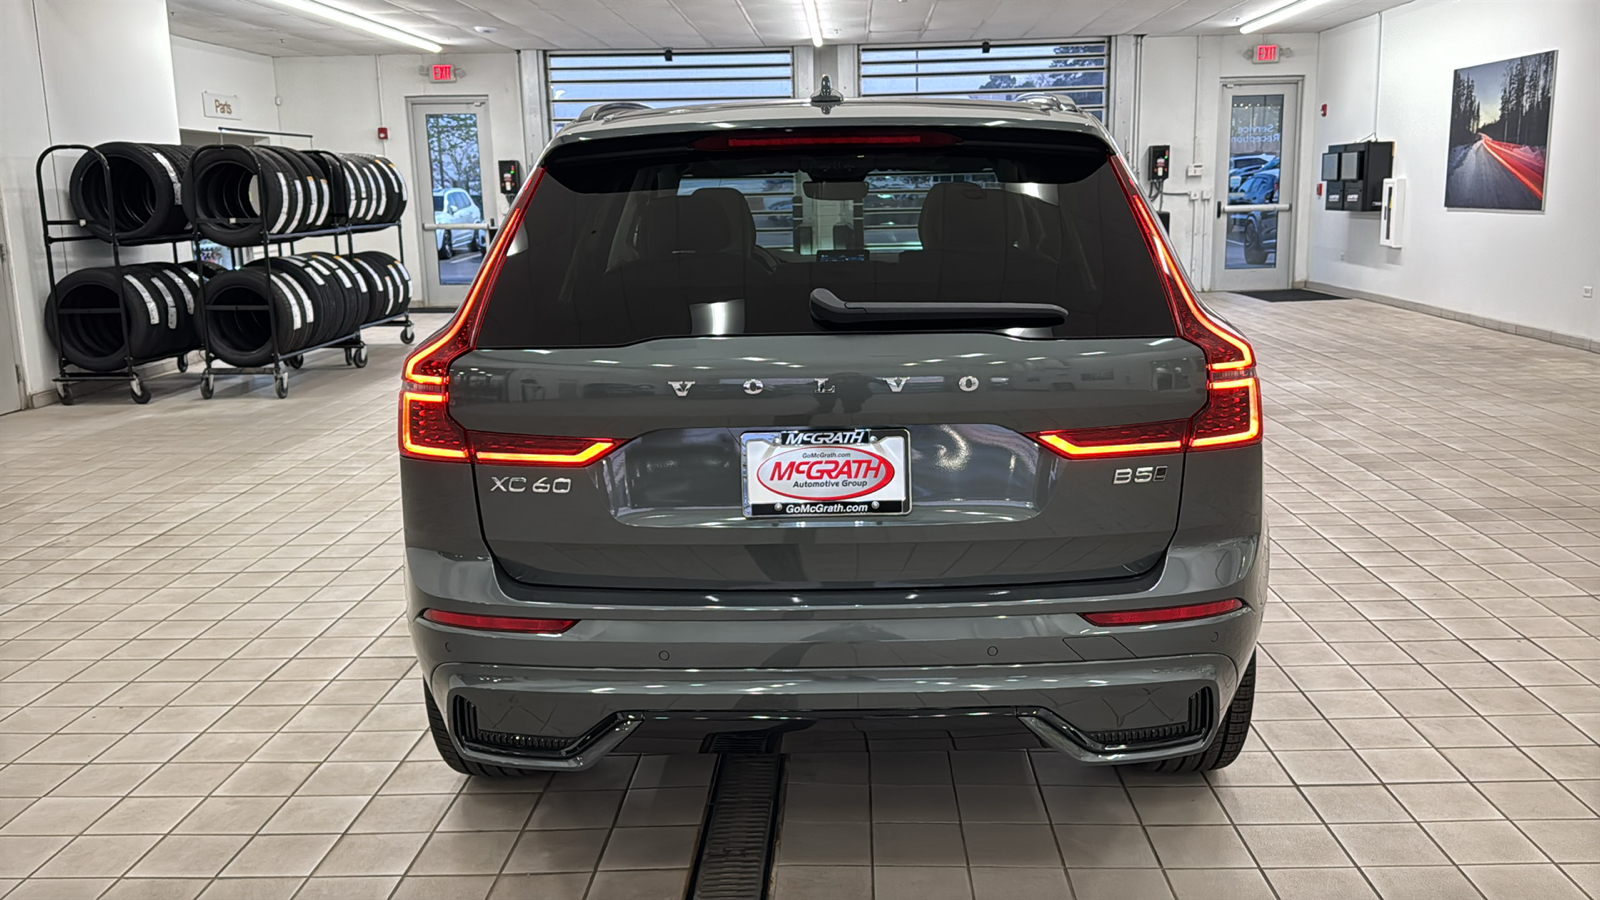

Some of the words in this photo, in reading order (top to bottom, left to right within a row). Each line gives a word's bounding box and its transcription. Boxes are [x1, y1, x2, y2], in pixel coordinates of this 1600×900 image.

[1257, 45, 1277, 60] EXIT
[432, 64, 451, 80] EXIT
[792, 480, 840, 488] Automotive
[841, 479, 868, 488] Group
[785, 503, 868, 514] GoMcGrath.com
